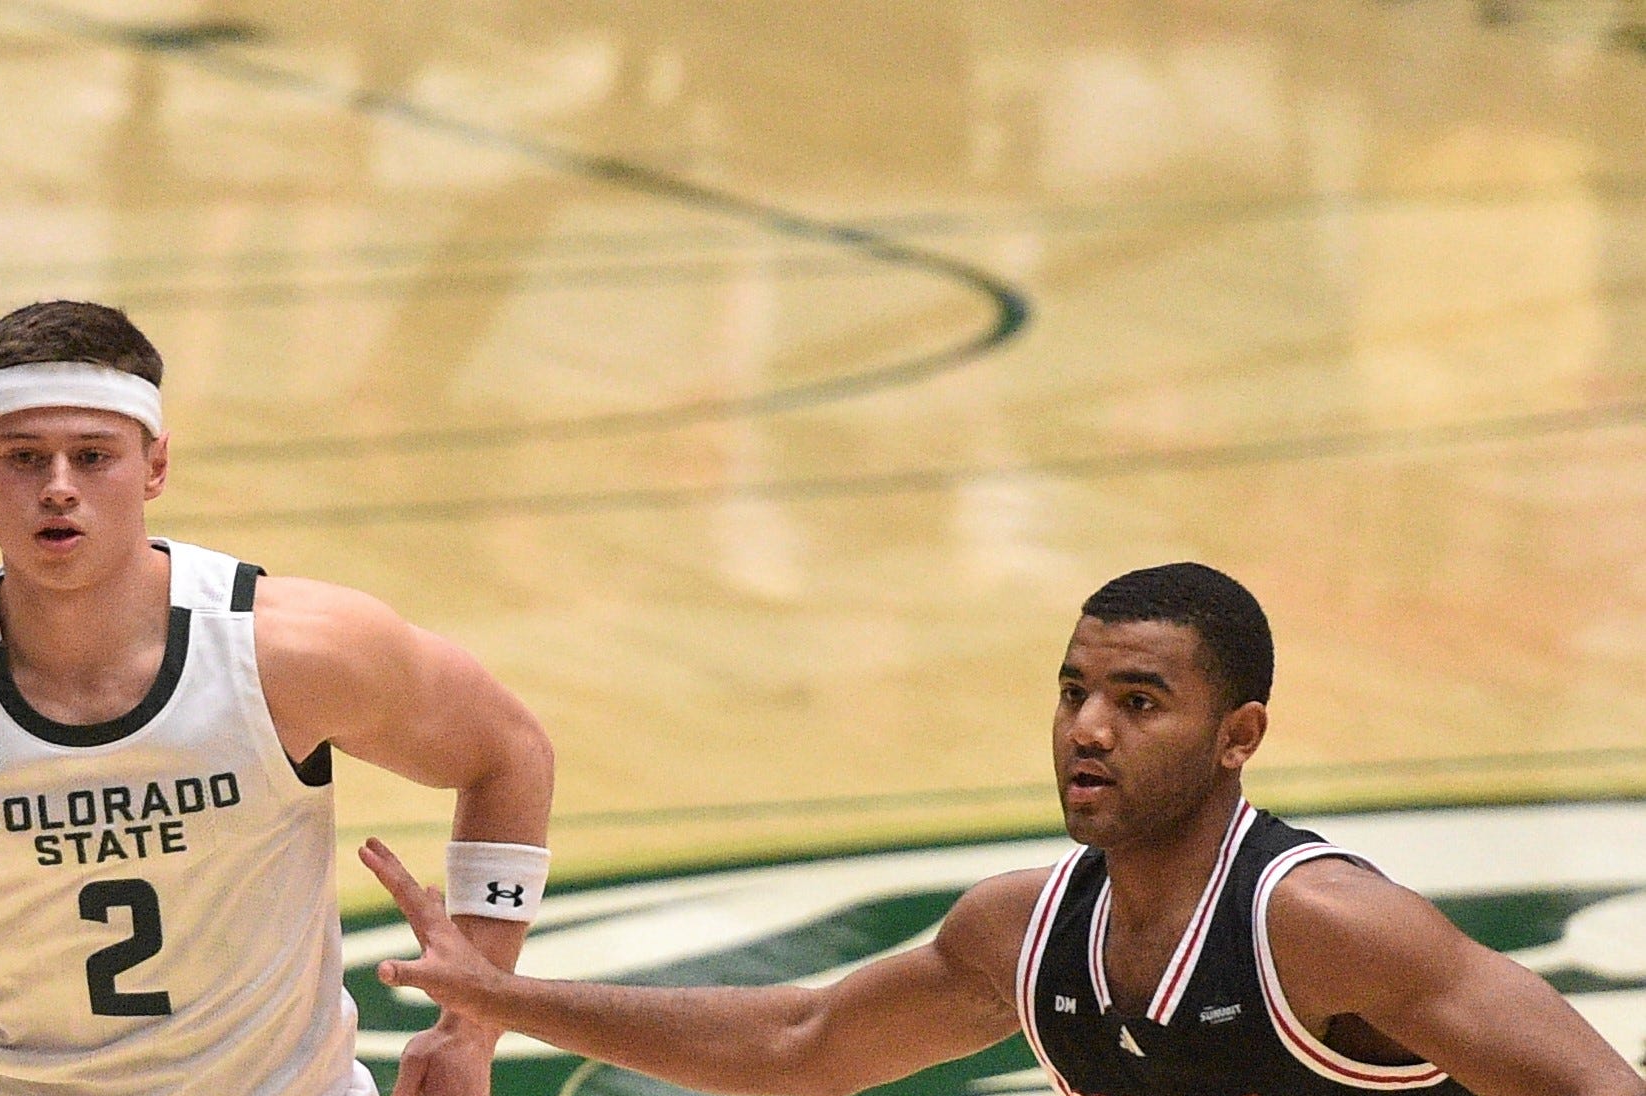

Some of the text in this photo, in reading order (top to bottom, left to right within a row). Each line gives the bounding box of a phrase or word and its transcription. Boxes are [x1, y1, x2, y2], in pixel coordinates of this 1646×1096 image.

[34, 821, 188, 866] STATE
[77, 878, 173, 1017] 2
[1055, 995, 1077, 1015] DM
